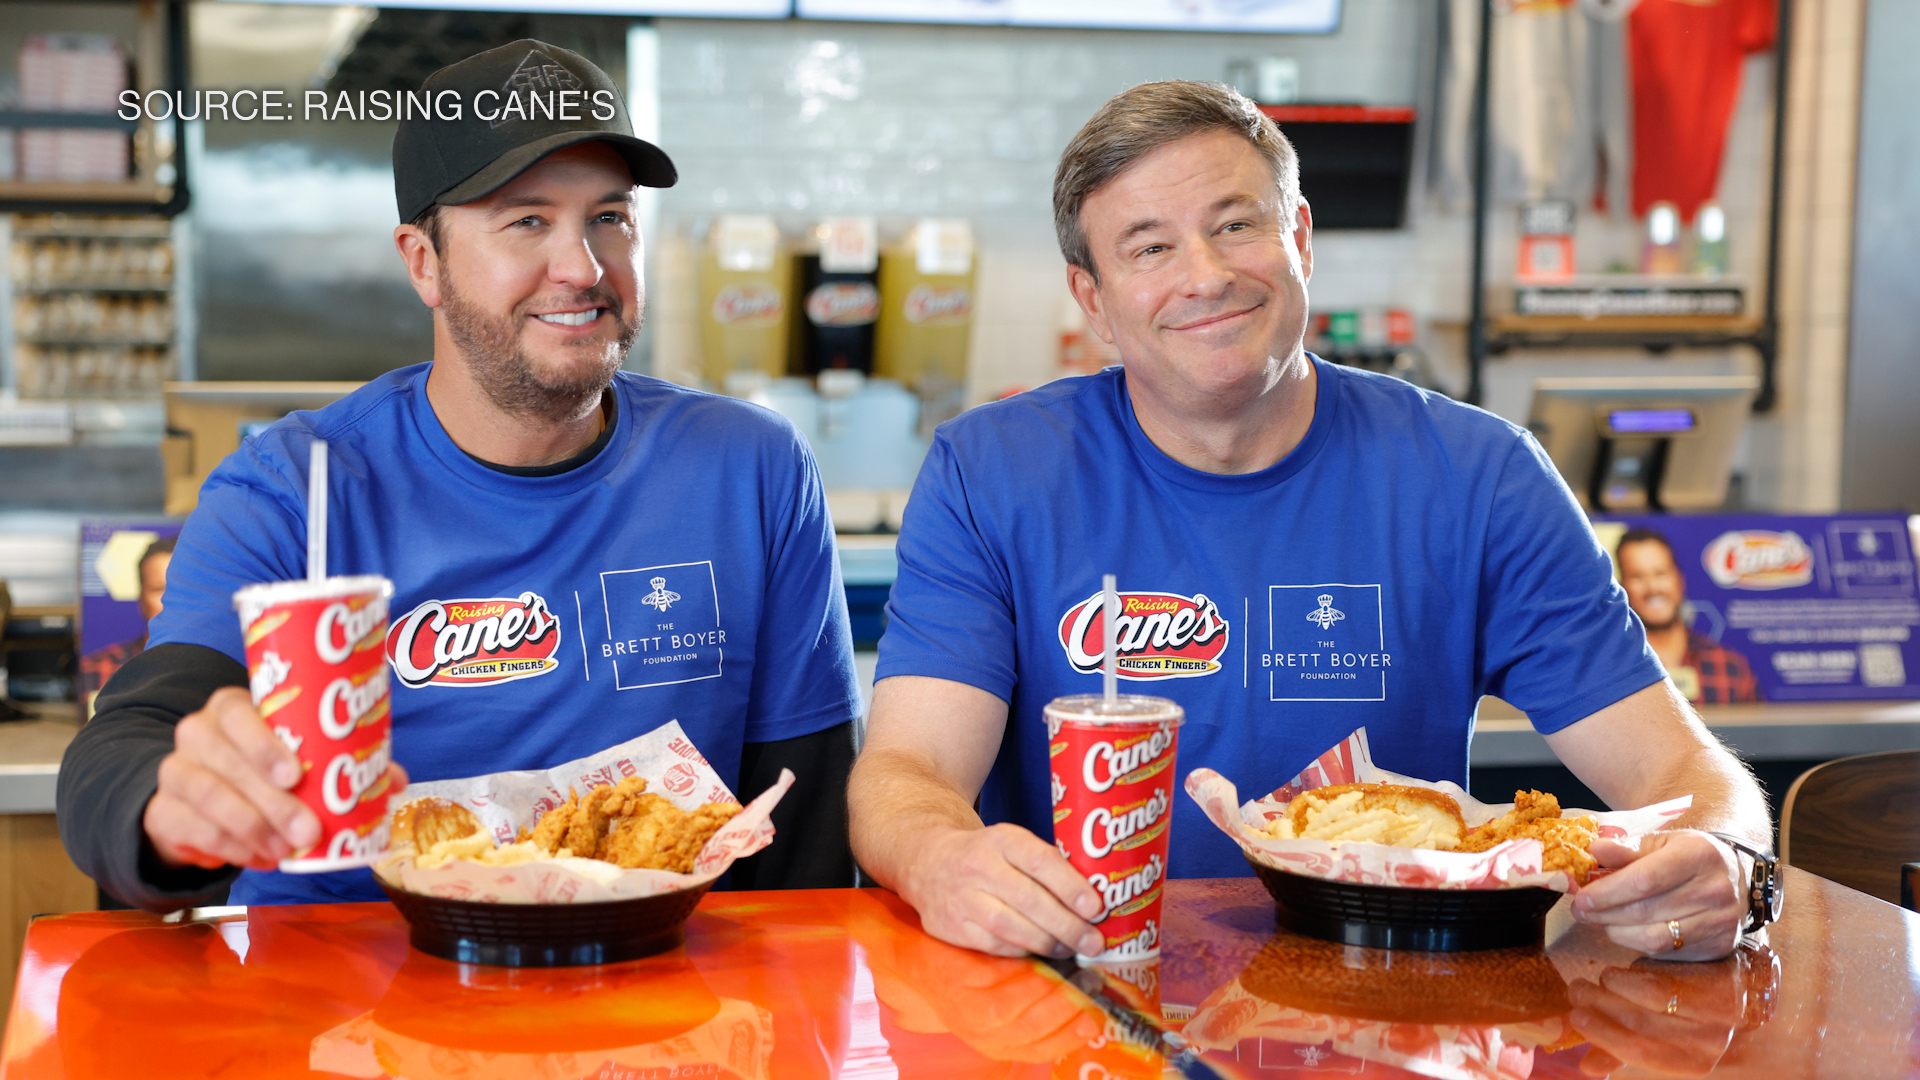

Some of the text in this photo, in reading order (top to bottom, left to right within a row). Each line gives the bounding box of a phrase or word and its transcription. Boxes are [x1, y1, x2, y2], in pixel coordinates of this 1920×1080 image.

[449, 604, 506, 622] Raising
[1125, 597, 1179, 614] Raising
[657, 622, 675, 631] THE
[1067, 591, 1226, 669] Cane's
[395, 593, 556, 682] Cane's
[602, 630, 727, 658] BRETT BOYER
[1317, 640, 1335, 648] THE
[643, 652, 698, 666] FOUNDATION
[1119, 658, 1208, 671] CHICKEN FINGERS
[1262, 653, 1392, 667] BRETT BOYER
[451, 660, 544, 676] CHICKEN FINGERS
[1300, 672, 1357, 680] FOUNDATION
[1083, 722, 1175, 793] Cane's
[1081, 788, 1169, 859] Cane's
